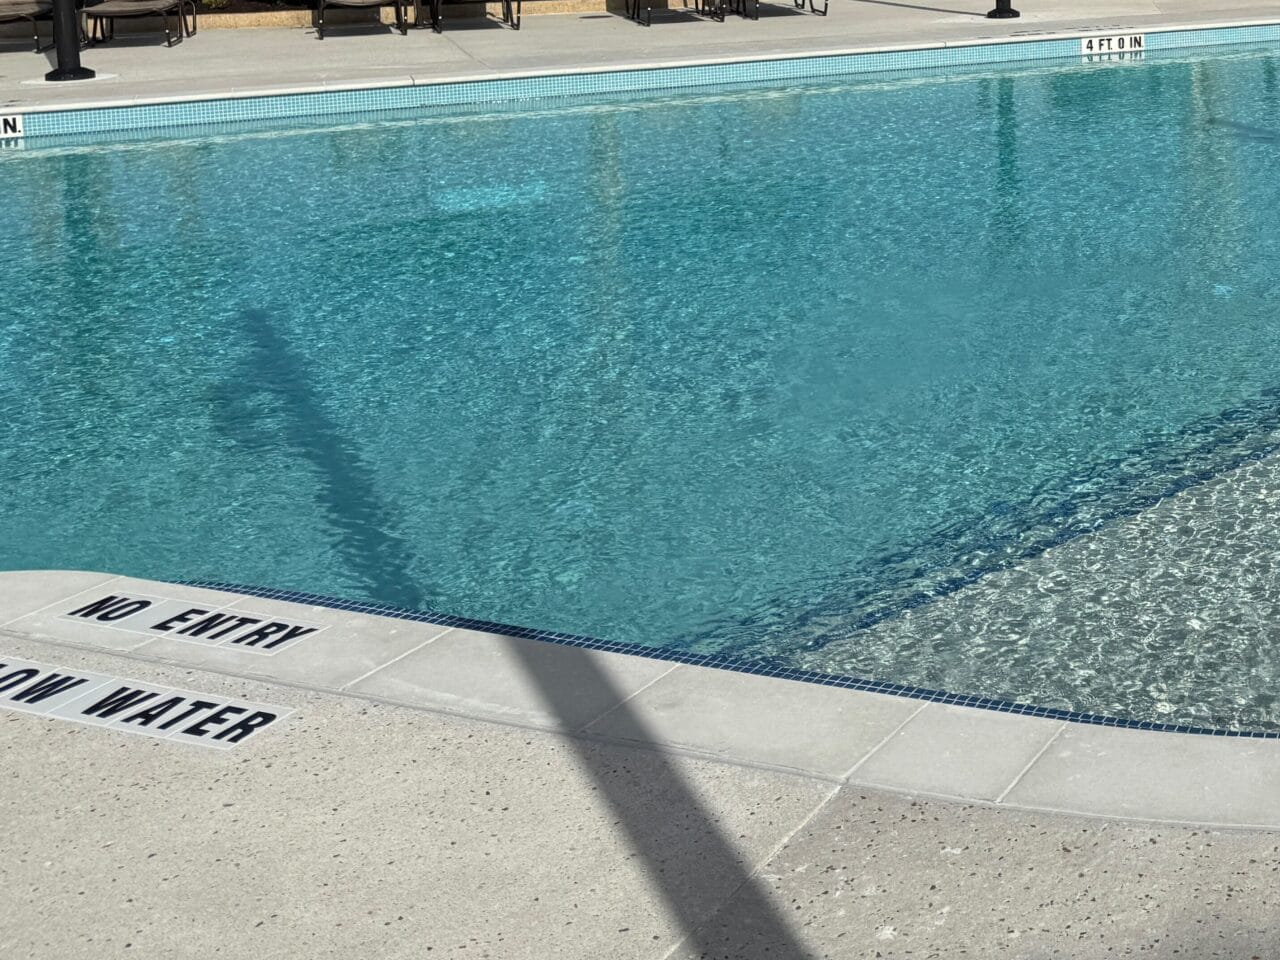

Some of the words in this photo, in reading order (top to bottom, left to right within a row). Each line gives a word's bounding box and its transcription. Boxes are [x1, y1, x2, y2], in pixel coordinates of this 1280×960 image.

[1086, 39, 1094, 51] 4
[0, 117, 21, 134] N.
[67, 595, 152, 622] NO
[150, 608, 319, 650] ENTRY
[0, 664, 90, 704] OW
[80, 686, 277, 743] WATER
